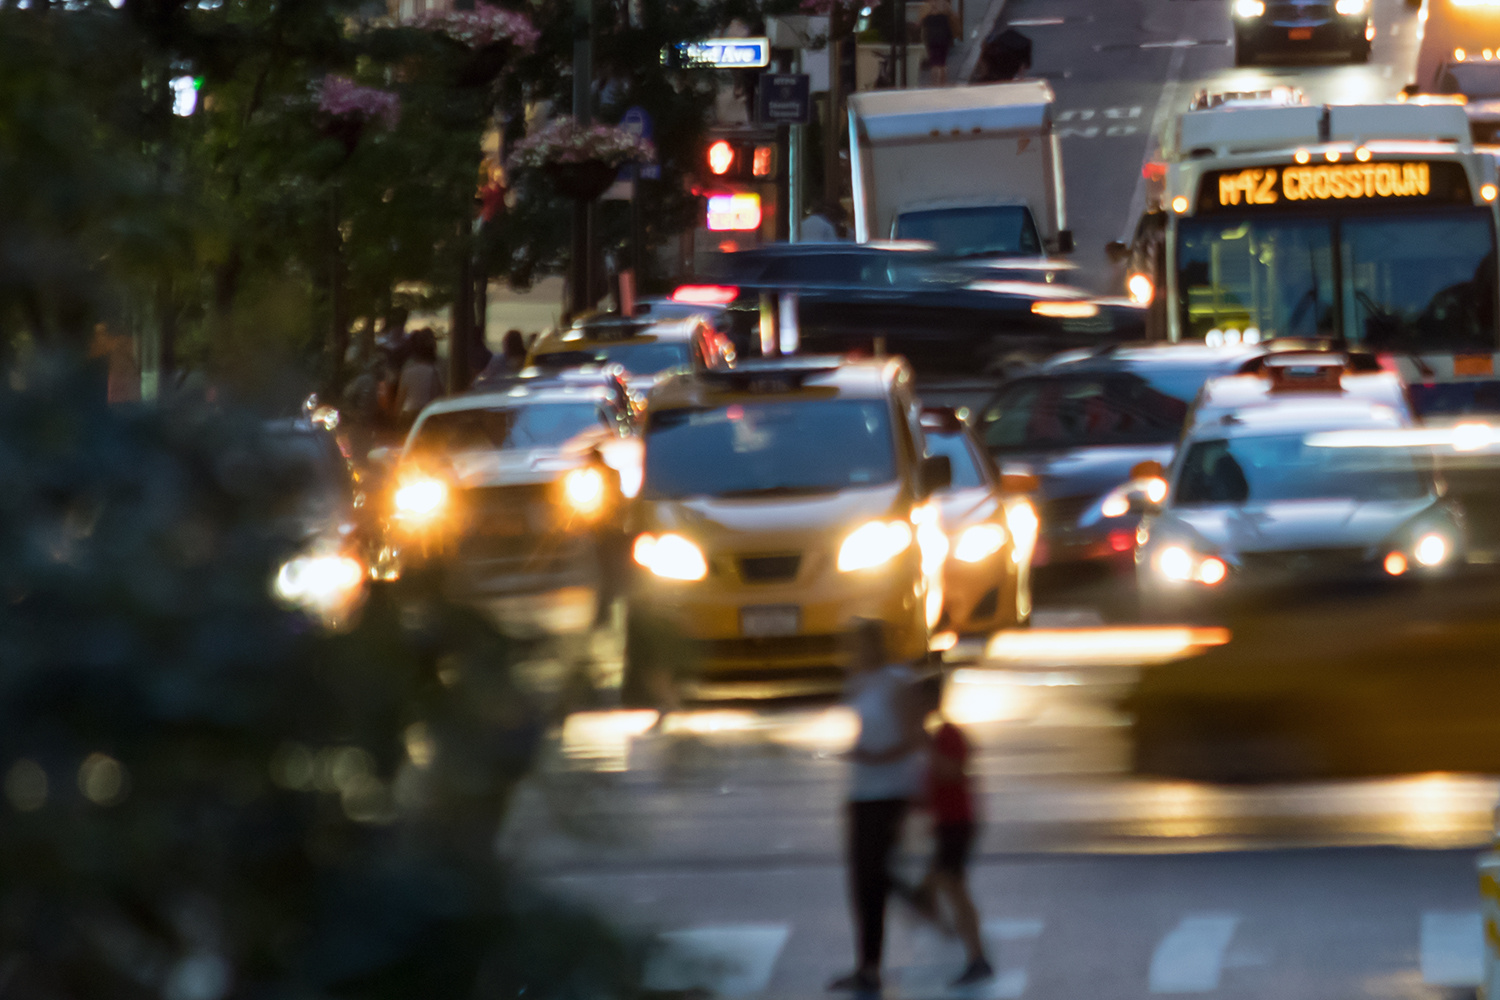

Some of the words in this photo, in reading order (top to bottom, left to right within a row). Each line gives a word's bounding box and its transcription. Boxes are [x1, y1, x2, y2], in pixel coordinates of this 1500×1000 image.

[722, 45, 755, 63] Ave
[1218, 167, 1280, 206] M42
[1282, 162, 1431, 201] CROSSTOWN
